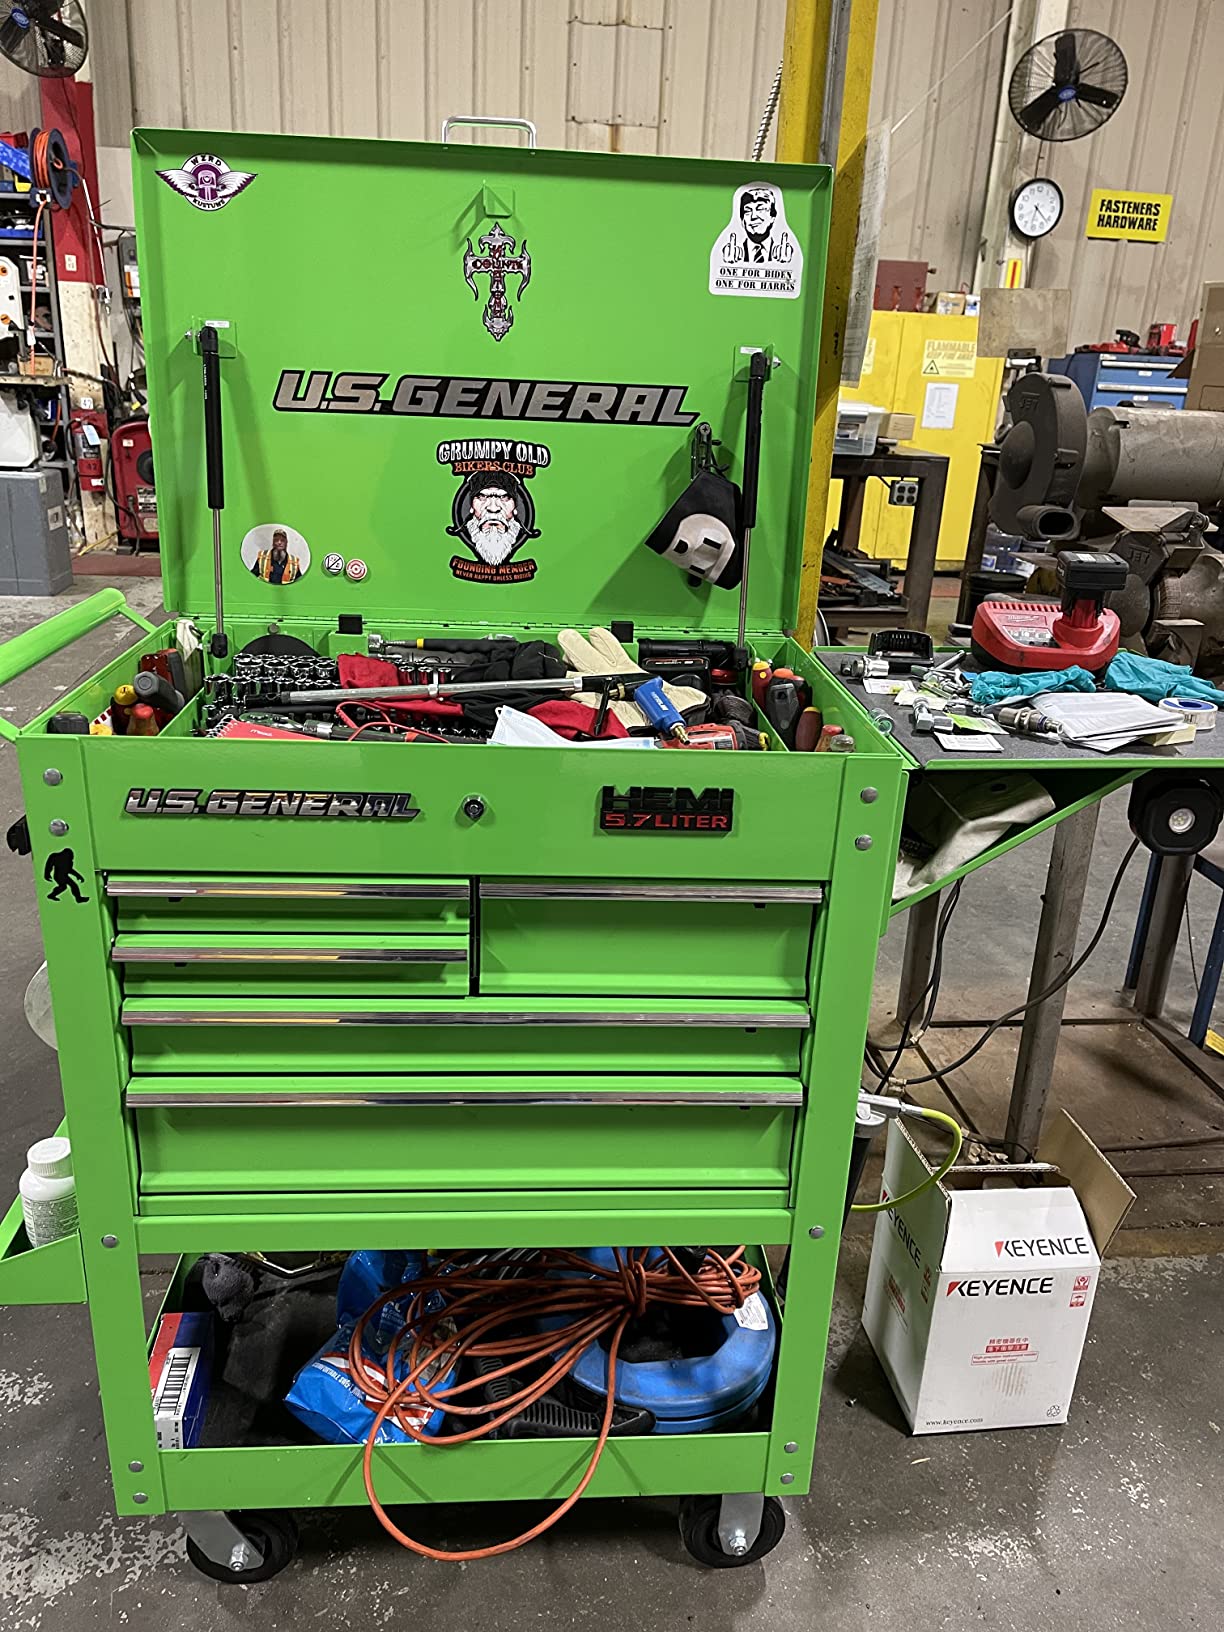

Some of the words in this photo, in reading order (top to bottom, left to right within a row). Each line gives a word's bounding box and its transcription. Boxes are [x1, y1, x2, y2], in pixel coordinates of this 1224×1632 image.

[1099, 198, 1161, 216] FASTENERS
[1097, 214, 1158, 232] HARDWARE
[719, 267, 738, 277] ONE
[742, 269, 760, 277] FOR
[764, 270, 793, 279] BIDEN
[715, 279, 734, 288] ONE
[738, 280, 756, 289] FOR
[760, 281, 795, 291] HARRIS
[927, 340, 976, 353] FLAMMABLE
[392, 378, 697, 424] GENERAL
[1018, 398, 1041, 411] JET
[438, 440, 513, 463] GRUMPY
[515, 443, 550, 466] OLD
[454, 460, 501, 473] BIKERS
[501, 463, 534, 476] CLUB
[452, 558, 497, 575] FOUNDING
[498, 560, 535, 575] MEMBER
[205, 790, 421, 818] GENERAL
[601, 785, 735, 810] HEMI
[604, 813, 652, 828] 5.7
[654, 814, 729, 829] LITER
[994, 1237, 1090, 1258] KEYENCE
[946, 1276, 1054, 1298] KEYENCE
